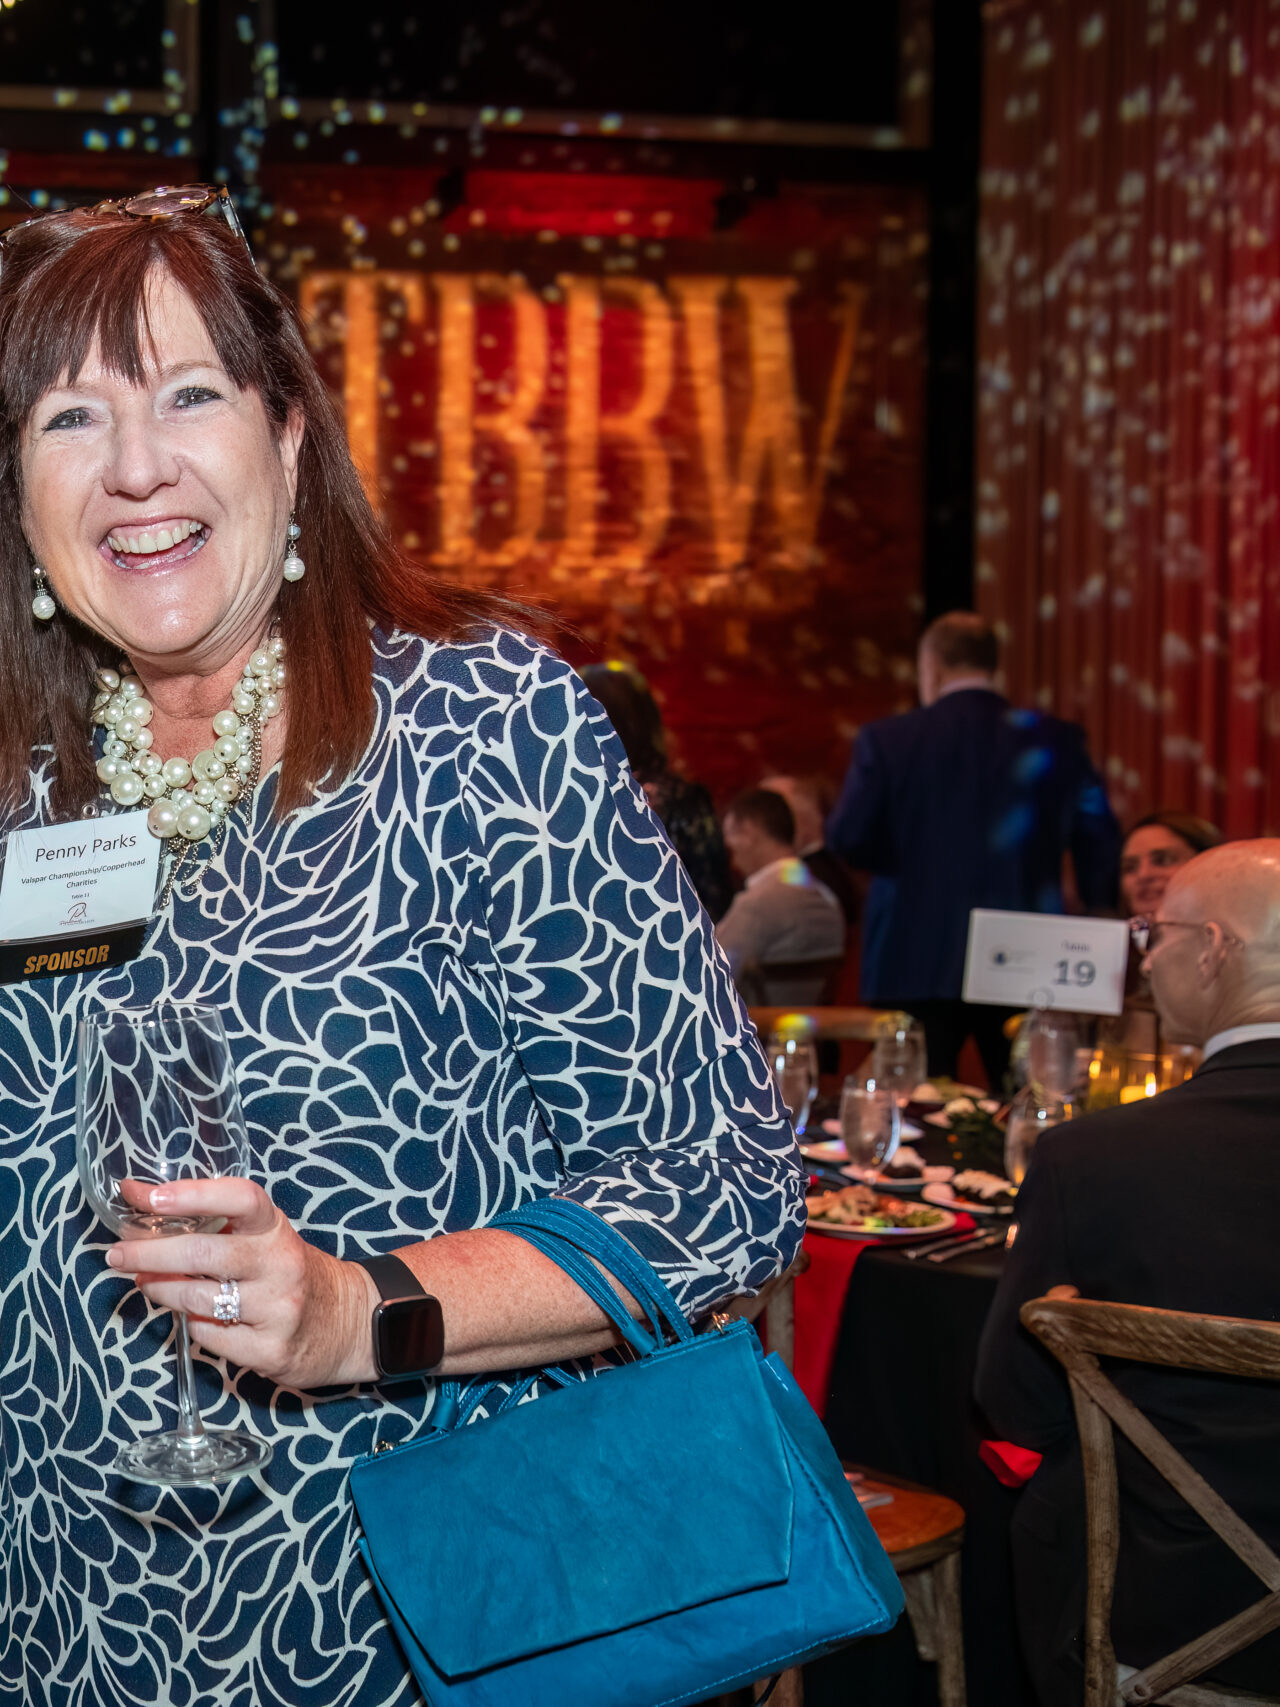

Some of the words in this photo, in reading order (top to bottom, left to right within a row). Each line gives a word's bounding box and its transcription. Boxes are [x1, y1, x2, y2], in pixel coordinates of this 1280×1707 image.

[302, 270, 865, 572] TBBW
[35, 843, 87, 863] Penny
[92, 834, 137, 854] Parks
[21, 874, 47, 885] Valspar
[48, 858, 146, 881] Championship/Copperhead
[66, 878, 98, 889] Charities
[23, 944, 110, 975] SPONSOR
[1053, 959, 1097, 987] 19
